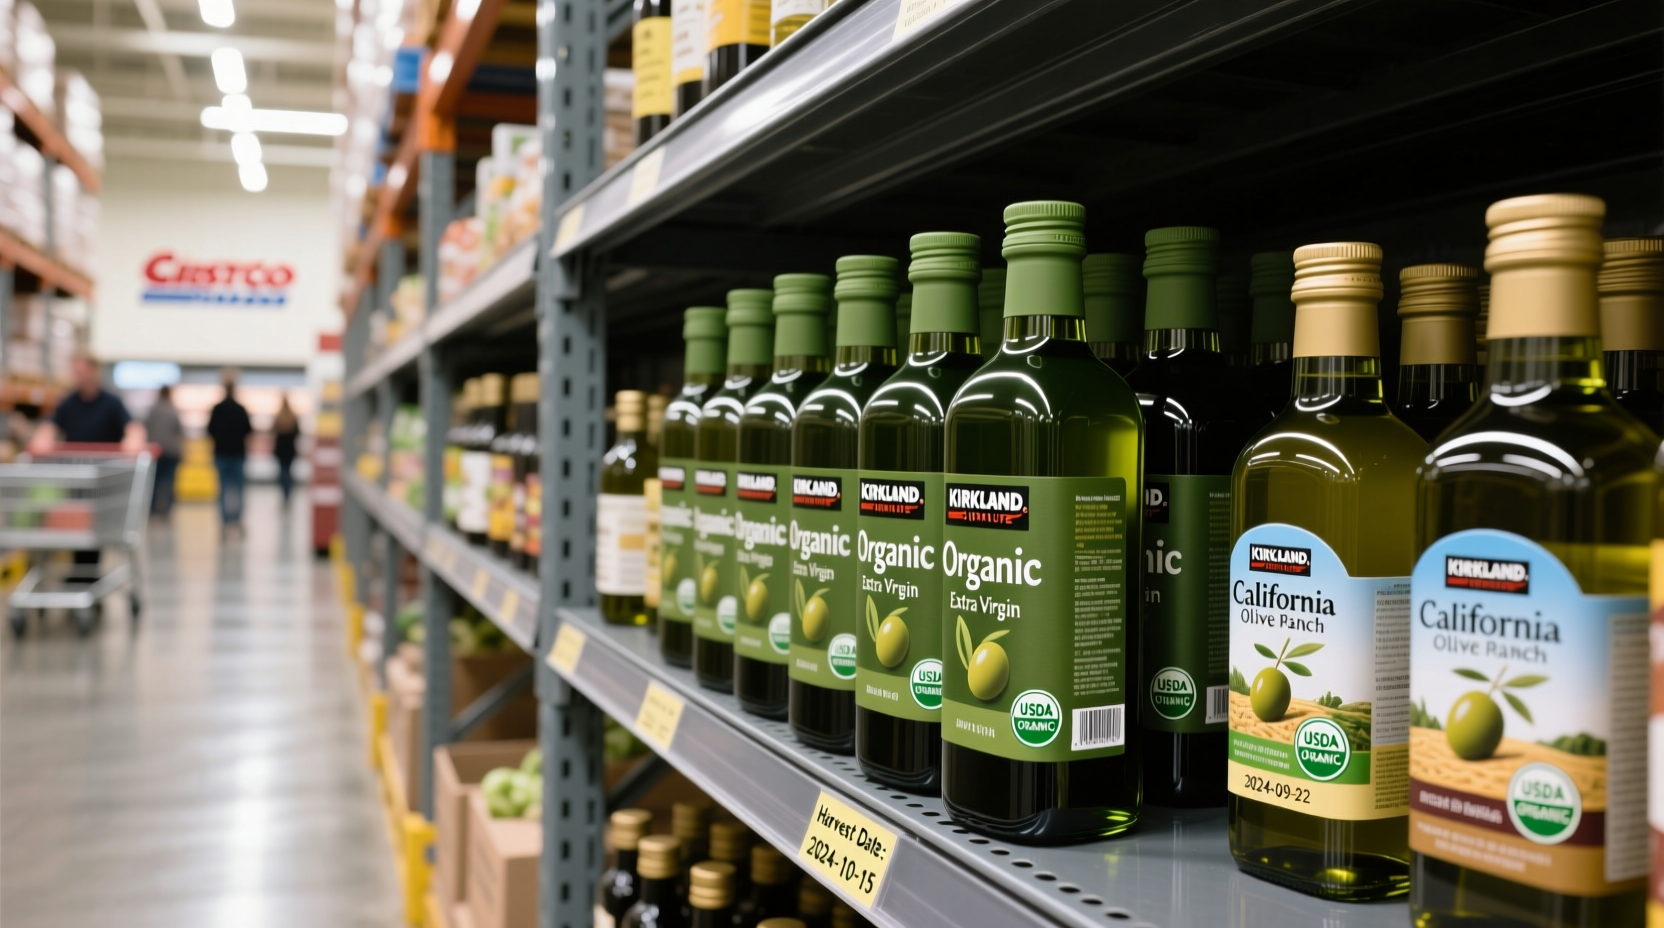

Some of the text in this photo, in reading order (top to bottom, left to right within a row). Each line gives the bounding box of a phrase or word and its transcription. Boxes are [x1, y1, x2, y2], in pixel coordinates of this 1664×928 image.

[789, 519, 851, 560] Organic
[858, 529, 935, 575] Organic
[943, 540, 1042, 591] Organic
[950, 591, 1021, 621] Extra Virgin
[1233, 579, 1336, 616] California
[1241, 608, 1324, 634] Olive Ranch
[1420, 599, 1561, 643] California
[1433, 634, 1548, 664] Olive Ranch
[1158, 677, 1187, 692] USDA
[1020, 702, 1053, 717] USDA
[1304, 731, 1339, 749] USDA
[1244, 774, 1311, 804] 2024-09-22
[1521, 780, 1564, 800] USDA
[806, 836, 876, 894] 2024-10-15
